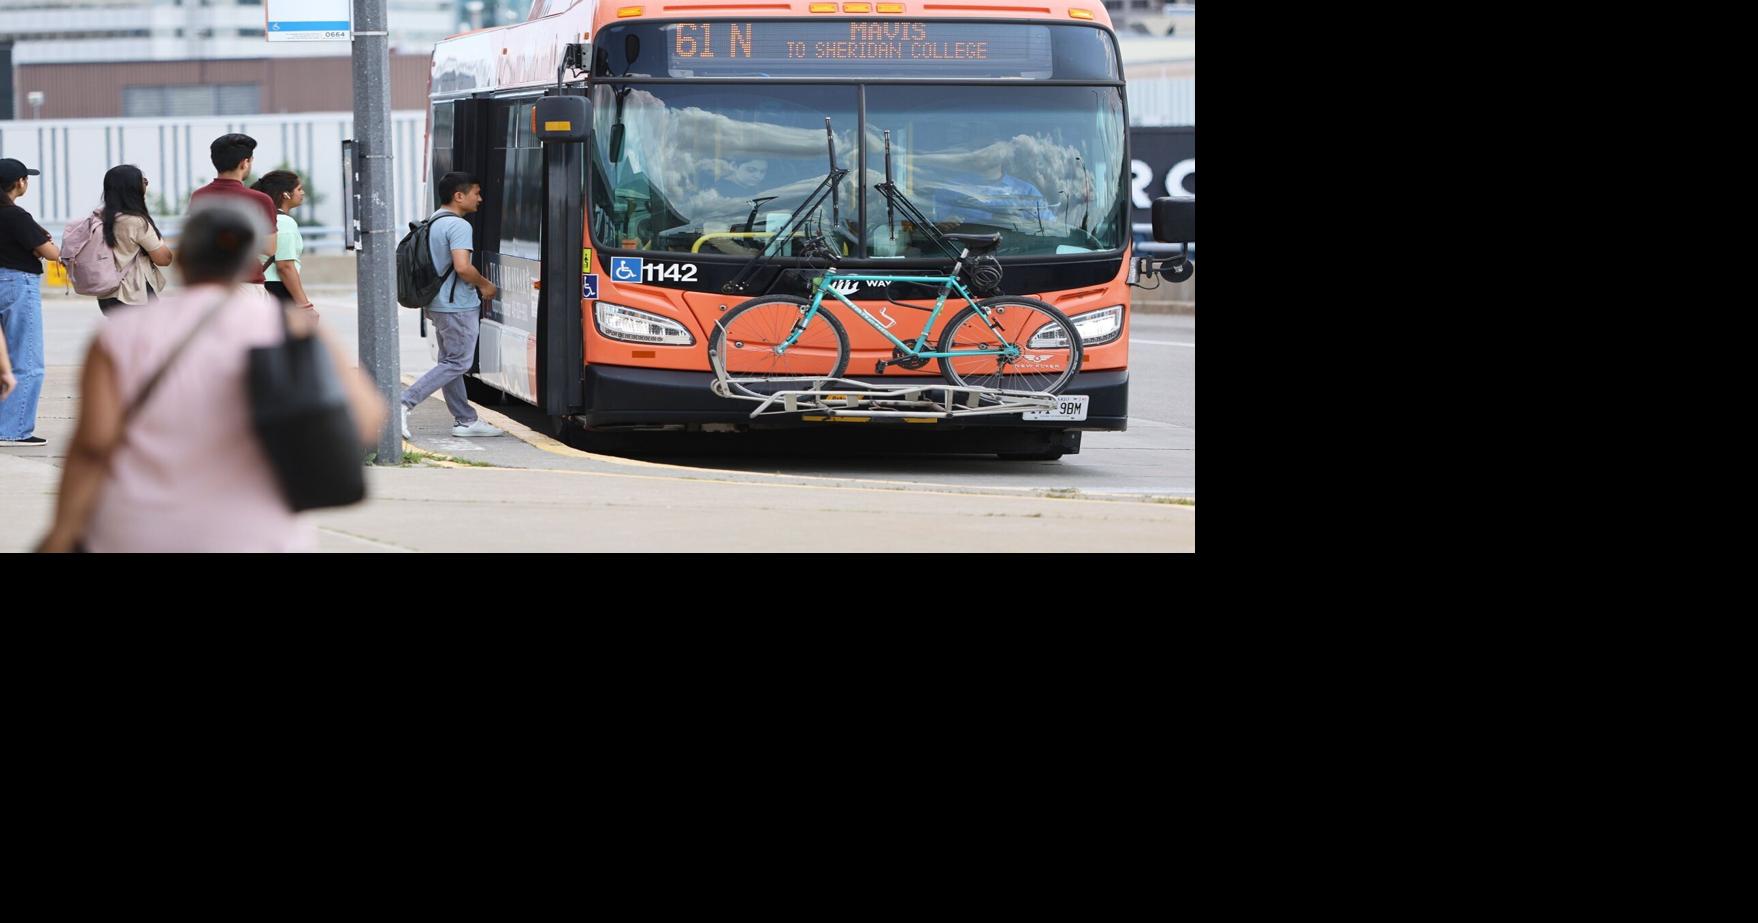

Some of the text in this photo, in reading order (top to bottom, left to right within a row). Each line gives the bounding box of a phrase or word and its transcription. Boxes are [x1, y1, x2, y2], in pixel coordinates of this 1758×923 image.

[676, 23, 752, 58] 61 N
[850, 22, 927, 41] MAVIS
[786, 41, 988, 59] TO SHERIDAN COLLEGE
[643, 263, 698, 282] 1142
[866, 279, 892, 288] WAY
[1059, 402, 1082, 415] 9BM
